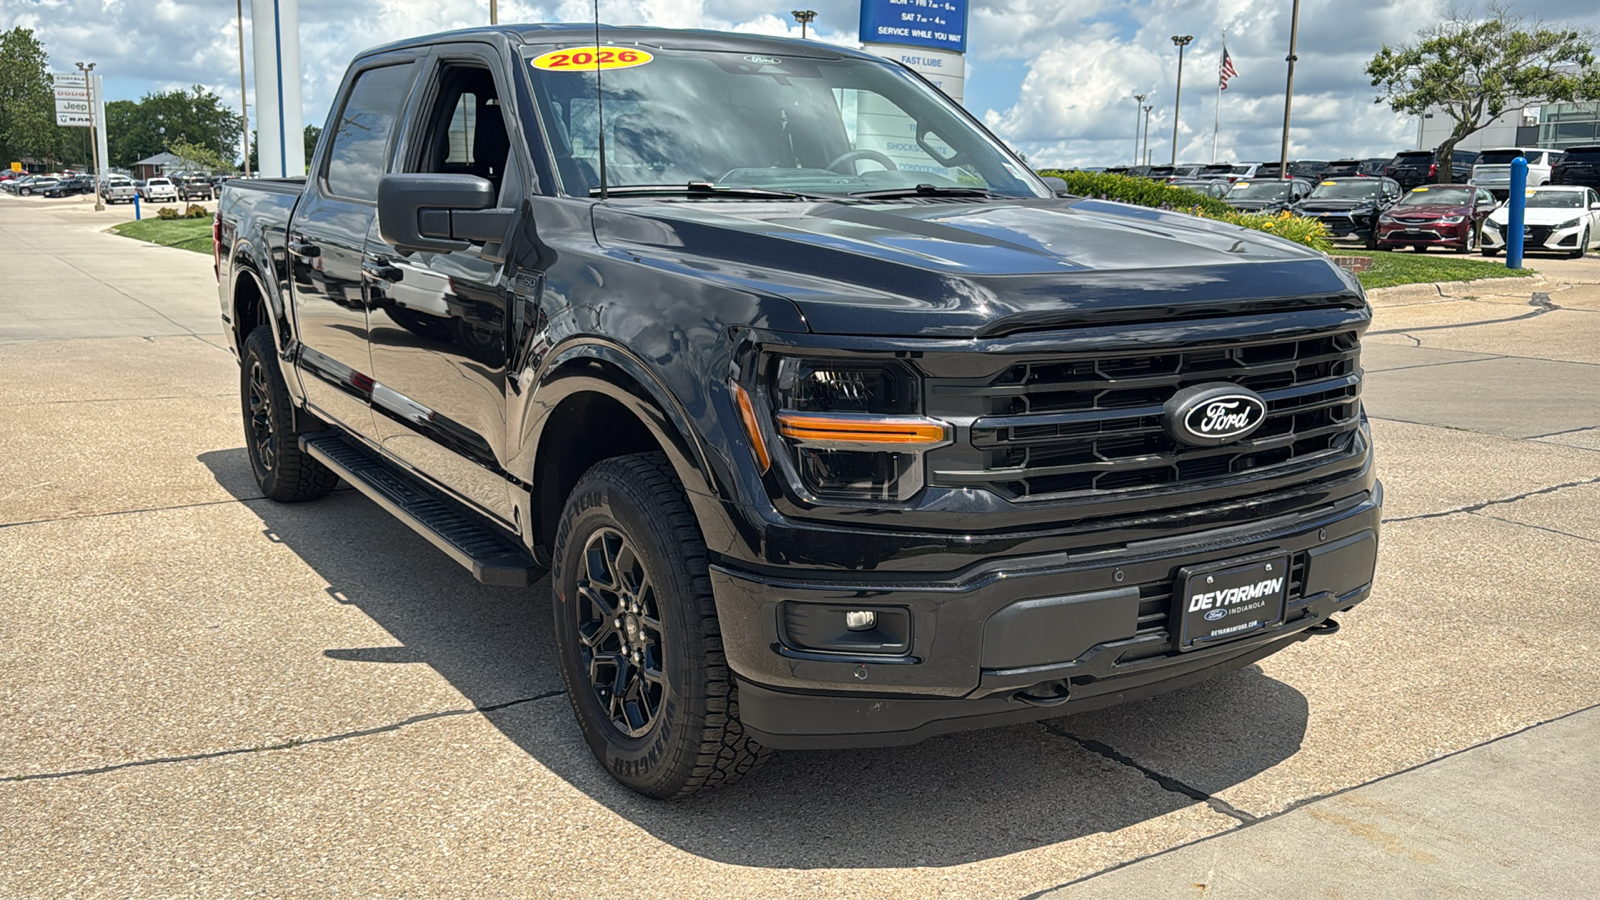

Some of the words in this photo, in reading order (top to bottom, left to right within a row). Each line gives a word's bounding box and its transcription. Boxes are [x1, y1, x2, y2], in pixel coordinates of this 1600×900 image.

[901, 13, 915, 21] SAT
[878, 26, 909, 36] SERVICE
[911, 29, 932, 39] WHILE
[934, 32, 947, 40] YOU
[948, 34, 961, 42] WAIT
[548, 51, 639, 67] 2026
[901, 56, 921, 65] FAST
[922, 58, 942, 67] LUBE
[64, 102, 87, 111] Jeep
[1201, 401, 1251, 432] Ford
[1188, 577, 1283, 612] DEYARMAN
[1229, 600, 1265, 615] INDIANOLA
[1211, 620, 1258, 636] DEYARMANFORD.COM
